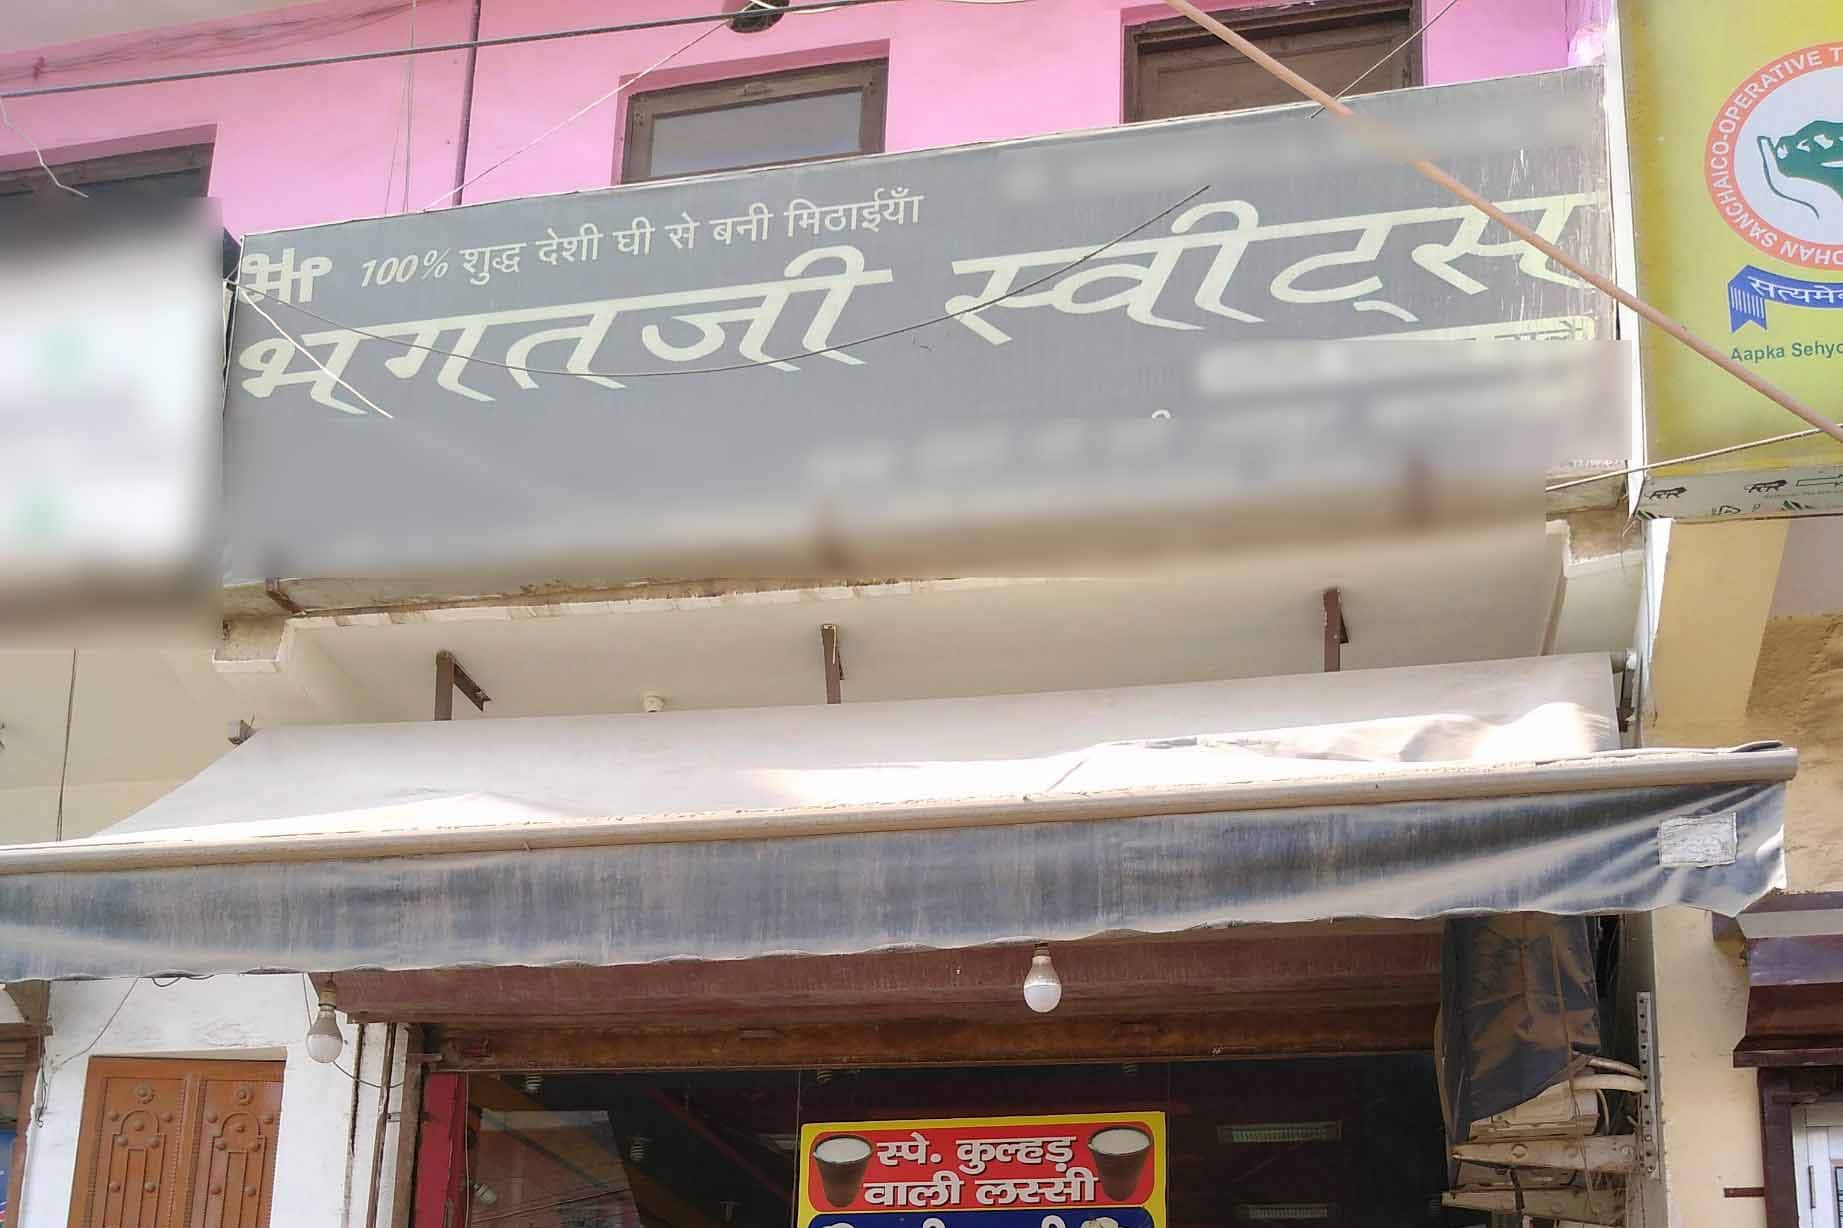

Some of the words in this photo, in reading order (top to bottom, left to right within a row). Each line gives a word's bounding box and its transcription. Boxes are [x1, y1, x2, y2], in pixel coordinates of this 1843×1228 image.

[361, 248, 449, 288] 100%
[459, 241, 527, 286] शुद्ध
[535, 222, 603, 265] देशी
[613, 216, 656, 256] घी
[664, 211, 701, 249] से
[709, 202, 774, 246] बनी
[784, 186, 924, 238] मिठाईयाँ
[238, 245, 893, 415] भगतजी
[1731, 345, 1785, 364] Aapka
[876, 1131, 942, 1167] स्पे.
[863, 1170, 965, 1207] वाली
